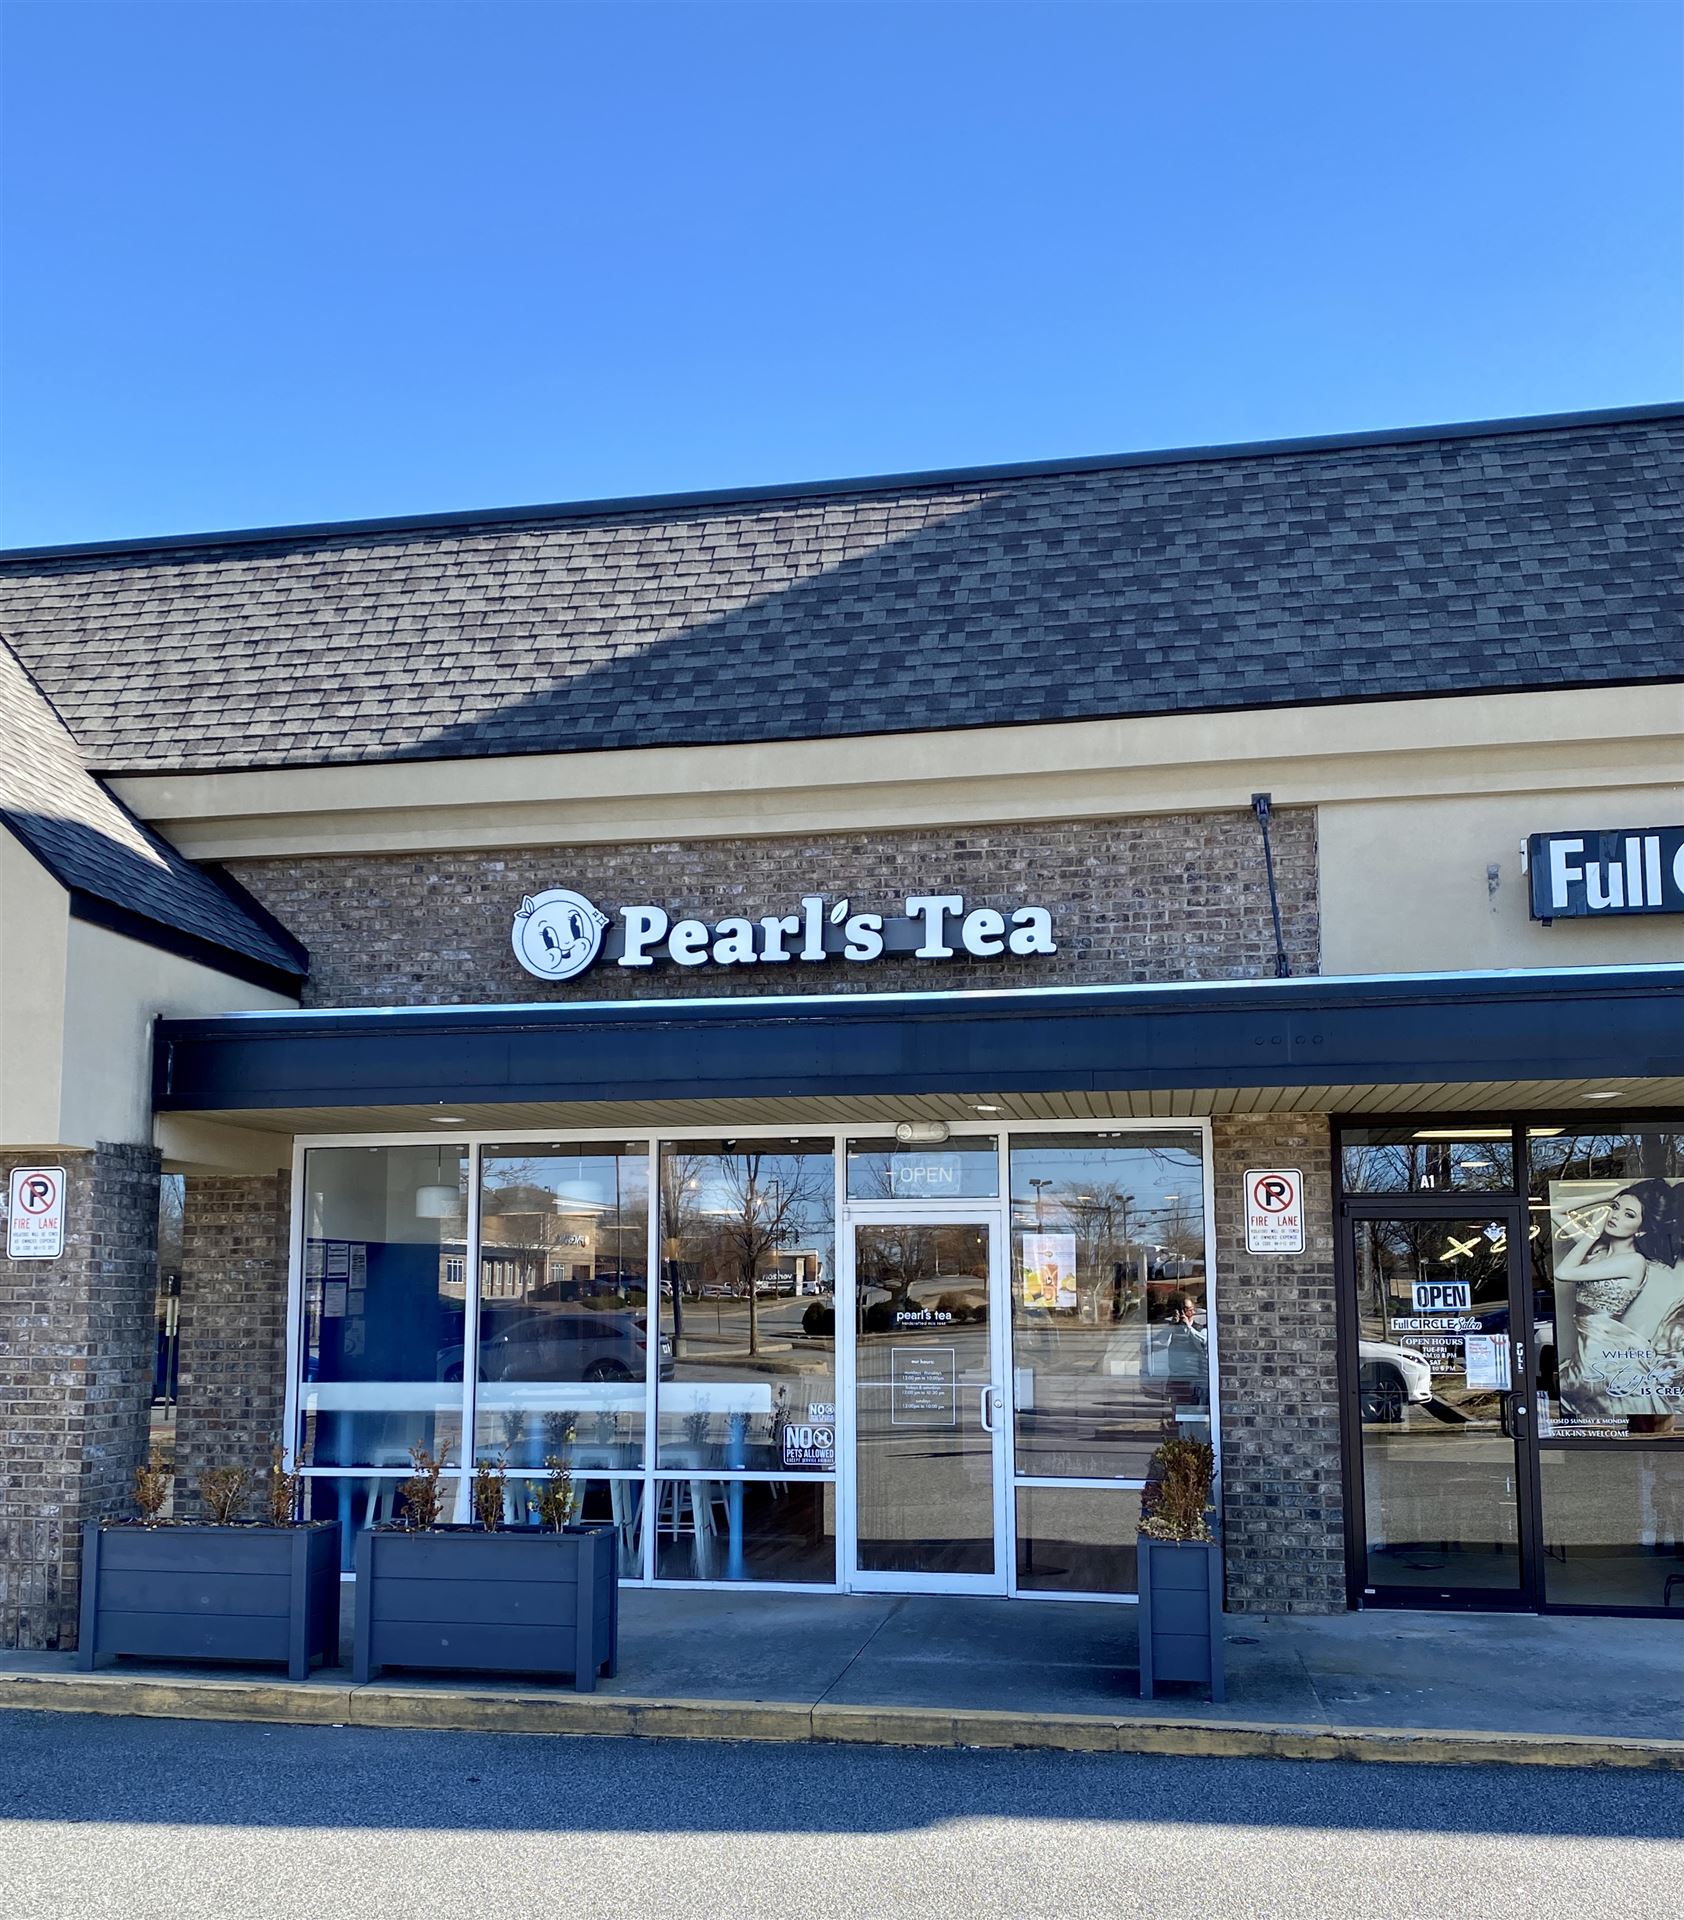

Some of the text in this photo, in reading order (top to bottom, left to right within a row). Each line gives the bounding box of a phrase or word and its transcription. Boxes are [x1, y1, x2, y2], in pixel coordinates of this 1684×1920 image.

[1550, 836, 1662, 909] Full
[618, 894, 1057, 967] Pearl's Tea
[900, 1167, 953, 1183] OPEN
[1420, 1174, 1435, 1189] A1
[13, 1217, 59, 1230] FIRE LANE
[1250, 1216, 1299, 1227] FIRE LANE
[1416, 1285, 1467, 1308] OPEN
[896, 1308, 952, 1322] pearl's tea
[1454, 1317, 1481, 1330] Salon
[1405, 1338, 1430, 1346] OPEN
[1432, 1338, 1464, 1346] HOURS
[1516, 1342, 1524, 1370] PULL
[1602, 1350, 1652, 1359] WHERE
[1641, 1387, 1652, 1395] IS
[810, 1404, 825, 1415] NO
[786, 1426, 813, 1449] NO
[1588, 1429, 1630, 1437] WELCOME
[786, 1449, 834, 1458] PETS ALLOWED
